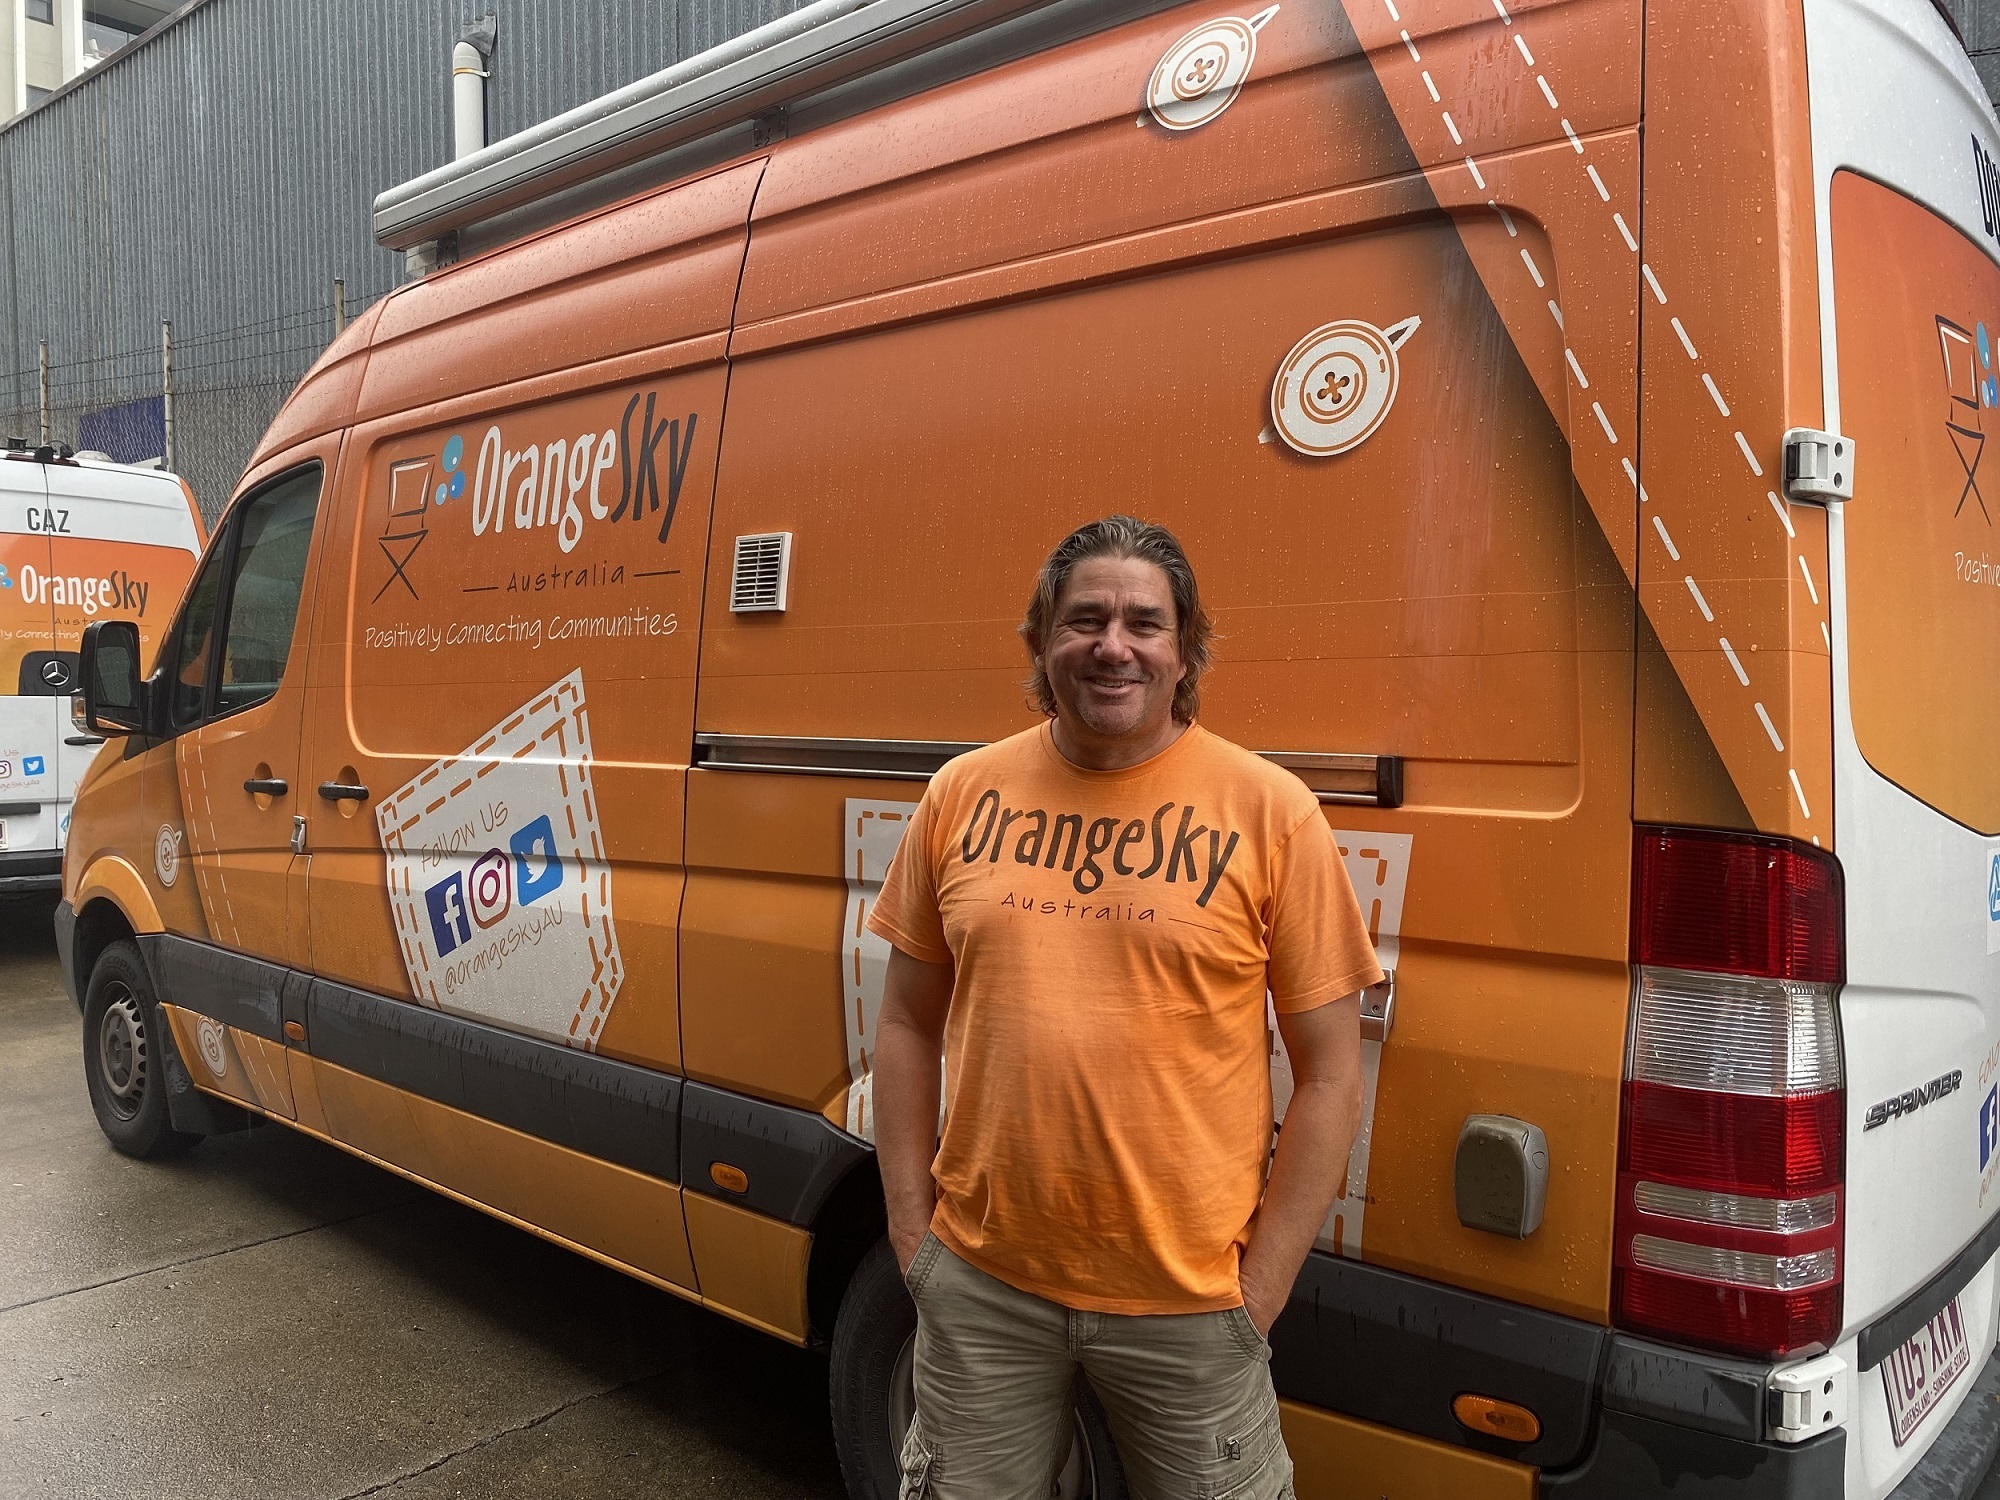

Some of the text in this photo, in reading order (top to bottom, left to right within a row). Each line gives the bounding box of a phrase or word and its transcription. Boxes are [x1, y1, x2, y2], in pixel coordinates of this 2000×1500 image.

[472, 391, 698, 553] OrangeSky
[26, 507, 71, 534] CAZ
[20, 564, 149, 618] OrangeSky
[507, 560, 625, 593] Australia
[1954, 551, 2000, 587] Positive
[16, 629, 80, 642] Connecting
[365, 606, 678, 651] Positively Connecting Communities
[421, 821, 476, 873] Follow
[962, 789, 1240, 907] OrangeSky
[1001, 891, 1155, 923] Australia
[1978, 1039, 2000, 1092] Follo
[1862, 1069, 1962, 1133] SPRINTER
